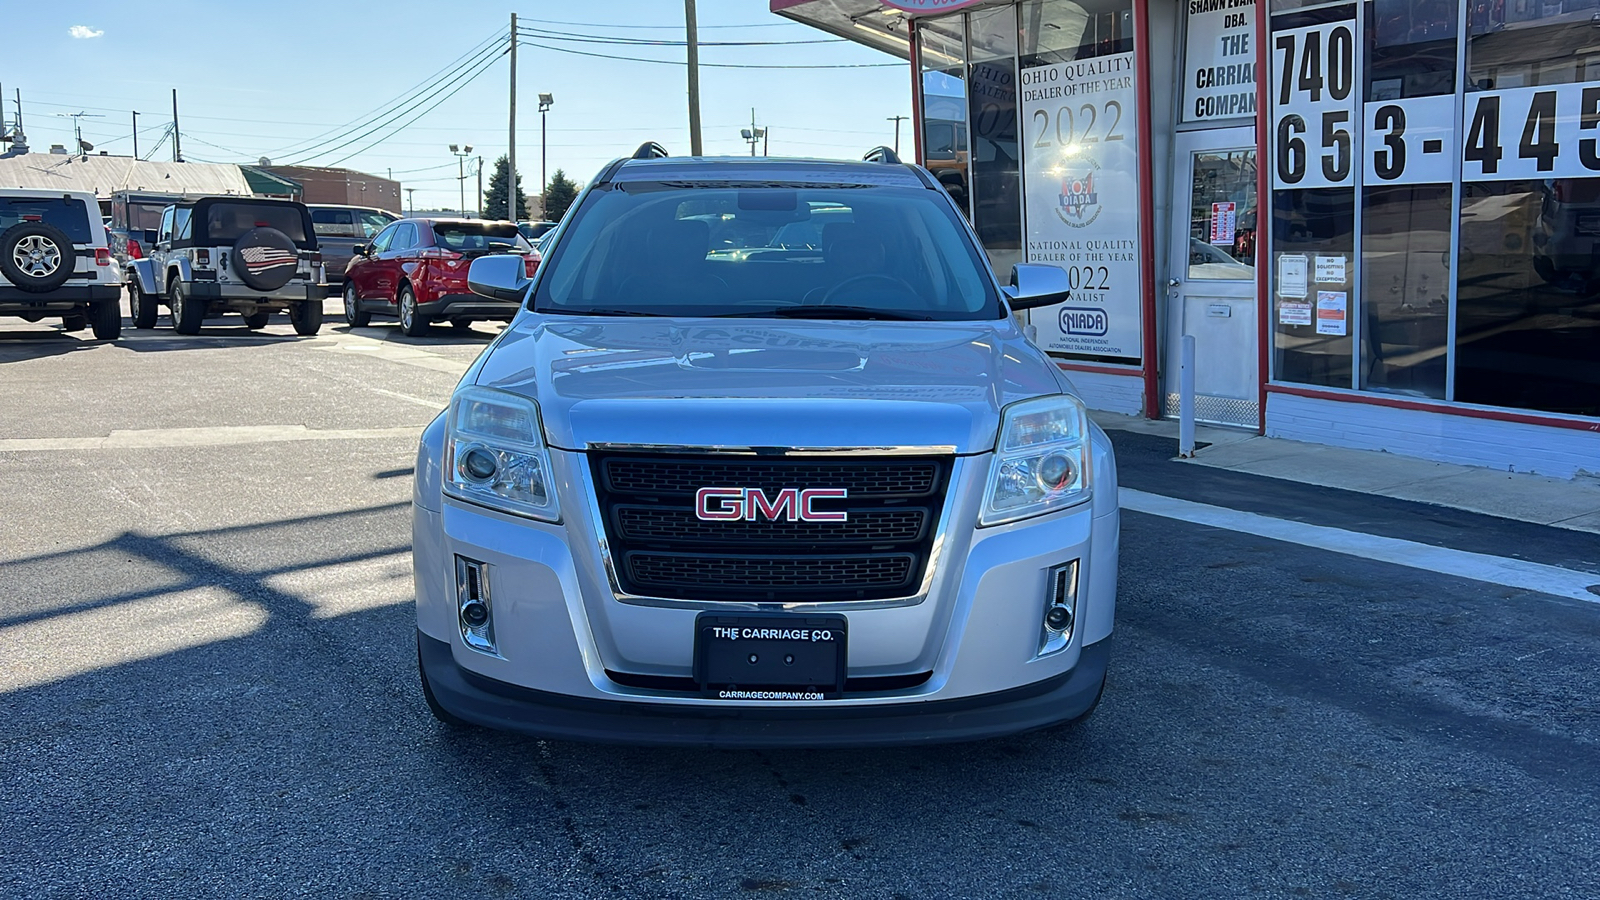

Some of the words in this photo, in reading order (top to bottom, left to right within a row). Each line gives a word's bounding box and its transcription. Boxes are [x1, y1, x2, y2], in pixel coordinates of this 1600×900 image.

[1190, 0, 1226, 15] SHAWN
[1224, 13, 1248, 29] DBA.
[1221, 33, 1249, 57] THE
[1022, 68, 1058, 85] OHIO
[1065, 57, 1133, 81] QUALITY
[1196, 62, 1257, 89] CARRIA
[1276, 26, 1353, 105] 740
[974, 81, 1009, 100] EALER
[1024, 86, 1062, 102] DEALER
[1064, 84, 1077, 97] OF
[1080, 80, 1101, 94] THE
[1102, 76, 1132, 91] YEAR
[1195, 92, 1257, 118] COMPAN
[1033, 100, 1124, 149] 2022
[1063, 194, 1091, 206] OIADA
[1029, 241, 1082, 250] NATIONAL
[1086, 240, 1135, 251] QUALITY
[1030, 253, 1066, 261] DEALER
[1069, 253, 1081, 261] OF
[1085, 253, 1104, 261] THE
[1108, 253, 1134, 261] YEAR
[1068, 265, 1110, 290] 022
[1069, 293, 1105, 302] NALIST
[1062, 312, 1104, 332] NIADA
[695, 487, 848, 521] GMC
[713, 627, 740, 639] THE
[742, 628, 809, 640] CARRIAGE
[812, 630, 834, 641] CO.
[719, 690, 824, 700] CARRIAGECOMPANY.COM
